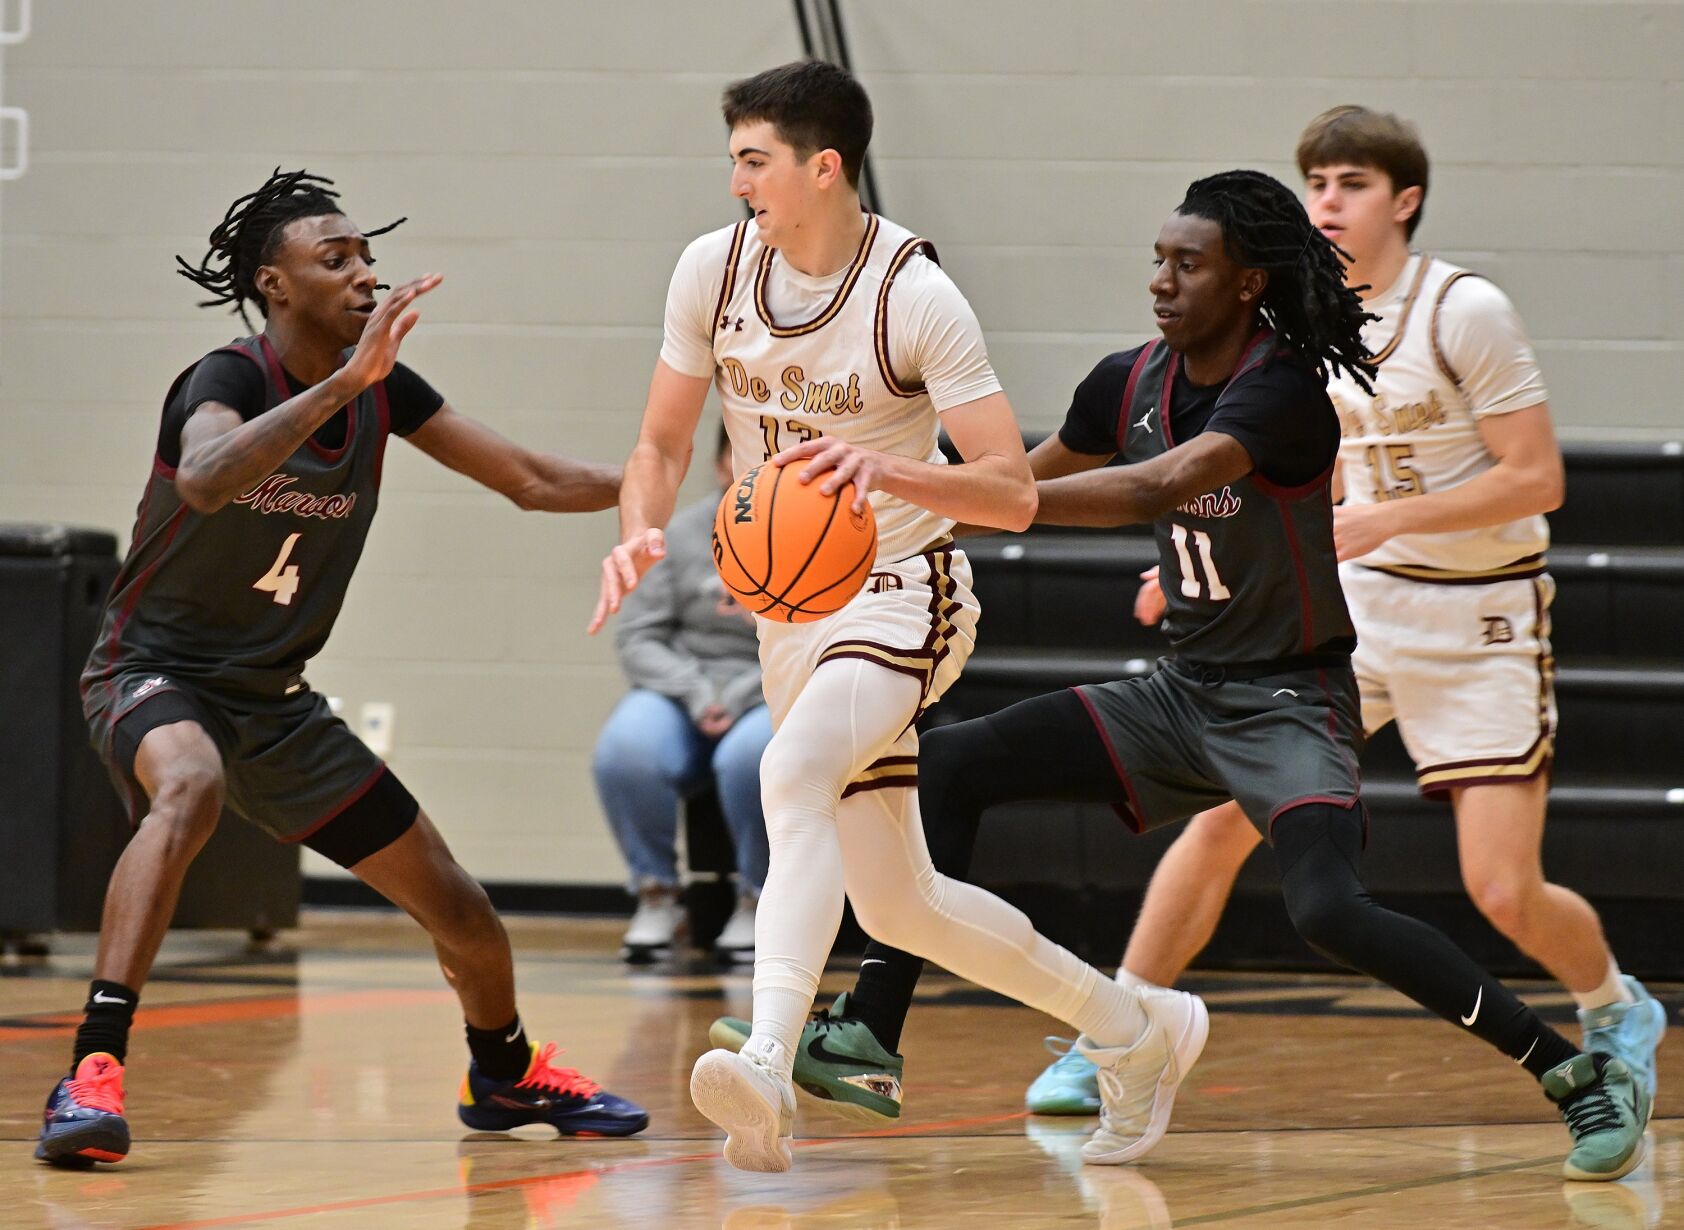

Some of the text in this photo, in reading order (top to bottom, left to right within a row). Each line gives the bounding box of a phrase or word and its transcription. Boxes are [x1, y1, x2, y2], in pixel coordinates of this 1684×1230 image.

[722, 357, 863, 415] De Smet
[1366, 444, 1426, 503] 15
[252, 532, 302, 606] 4
[1170, 523, 1231, 601] 11
